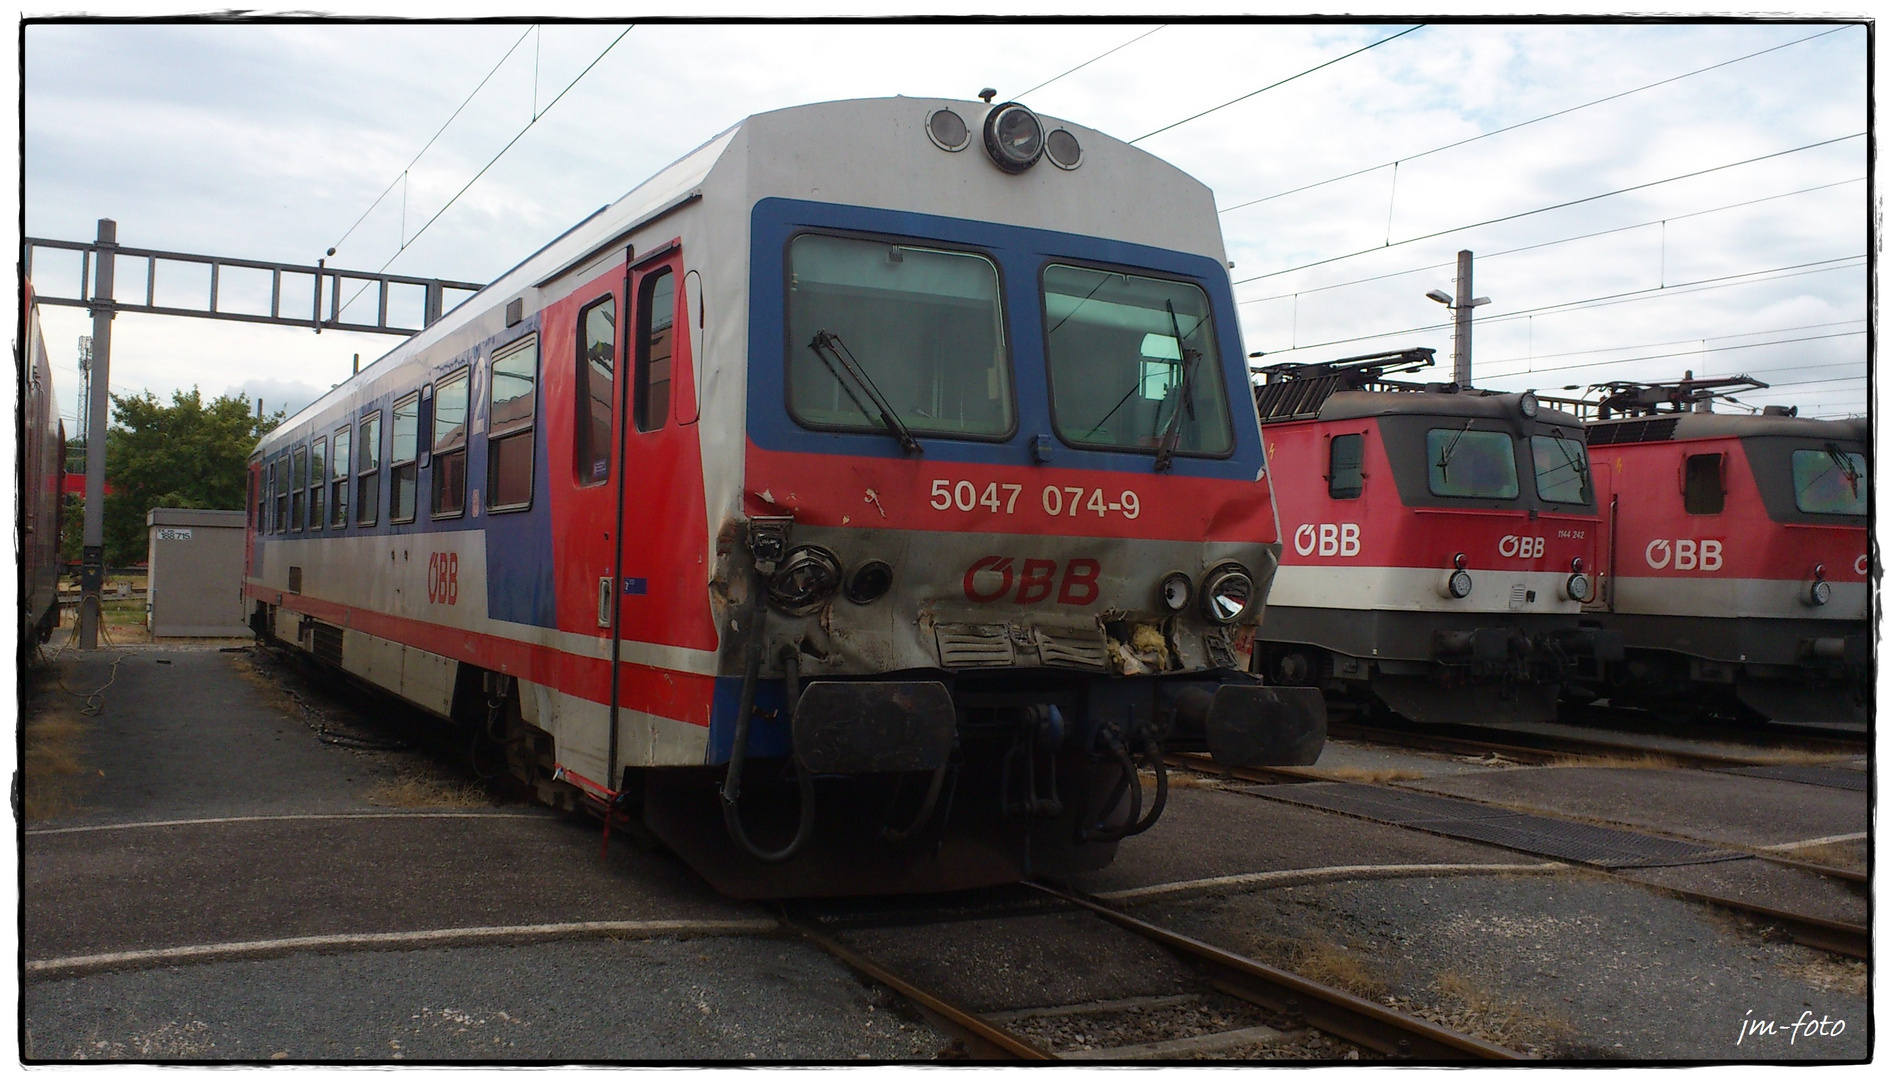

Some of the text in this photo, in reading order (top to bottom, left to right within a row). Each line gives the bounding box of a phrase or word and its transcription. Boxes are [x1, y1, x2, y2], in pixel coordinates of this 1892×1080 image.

[472, 357, 486, 436] 2
[930, 479, 1140, 520] 5047 074-9
[1293, 523, 1361, 558] ÖBB
[1498, 534, 1545, 560] ÖBB
[1557, 530, 1585, 539] 1144 242
[1645, 538, 1723, 571] ÖBB
[428, 551, 458, 606] ÖBB
[963, 555, 1102, 606] ÖBB
